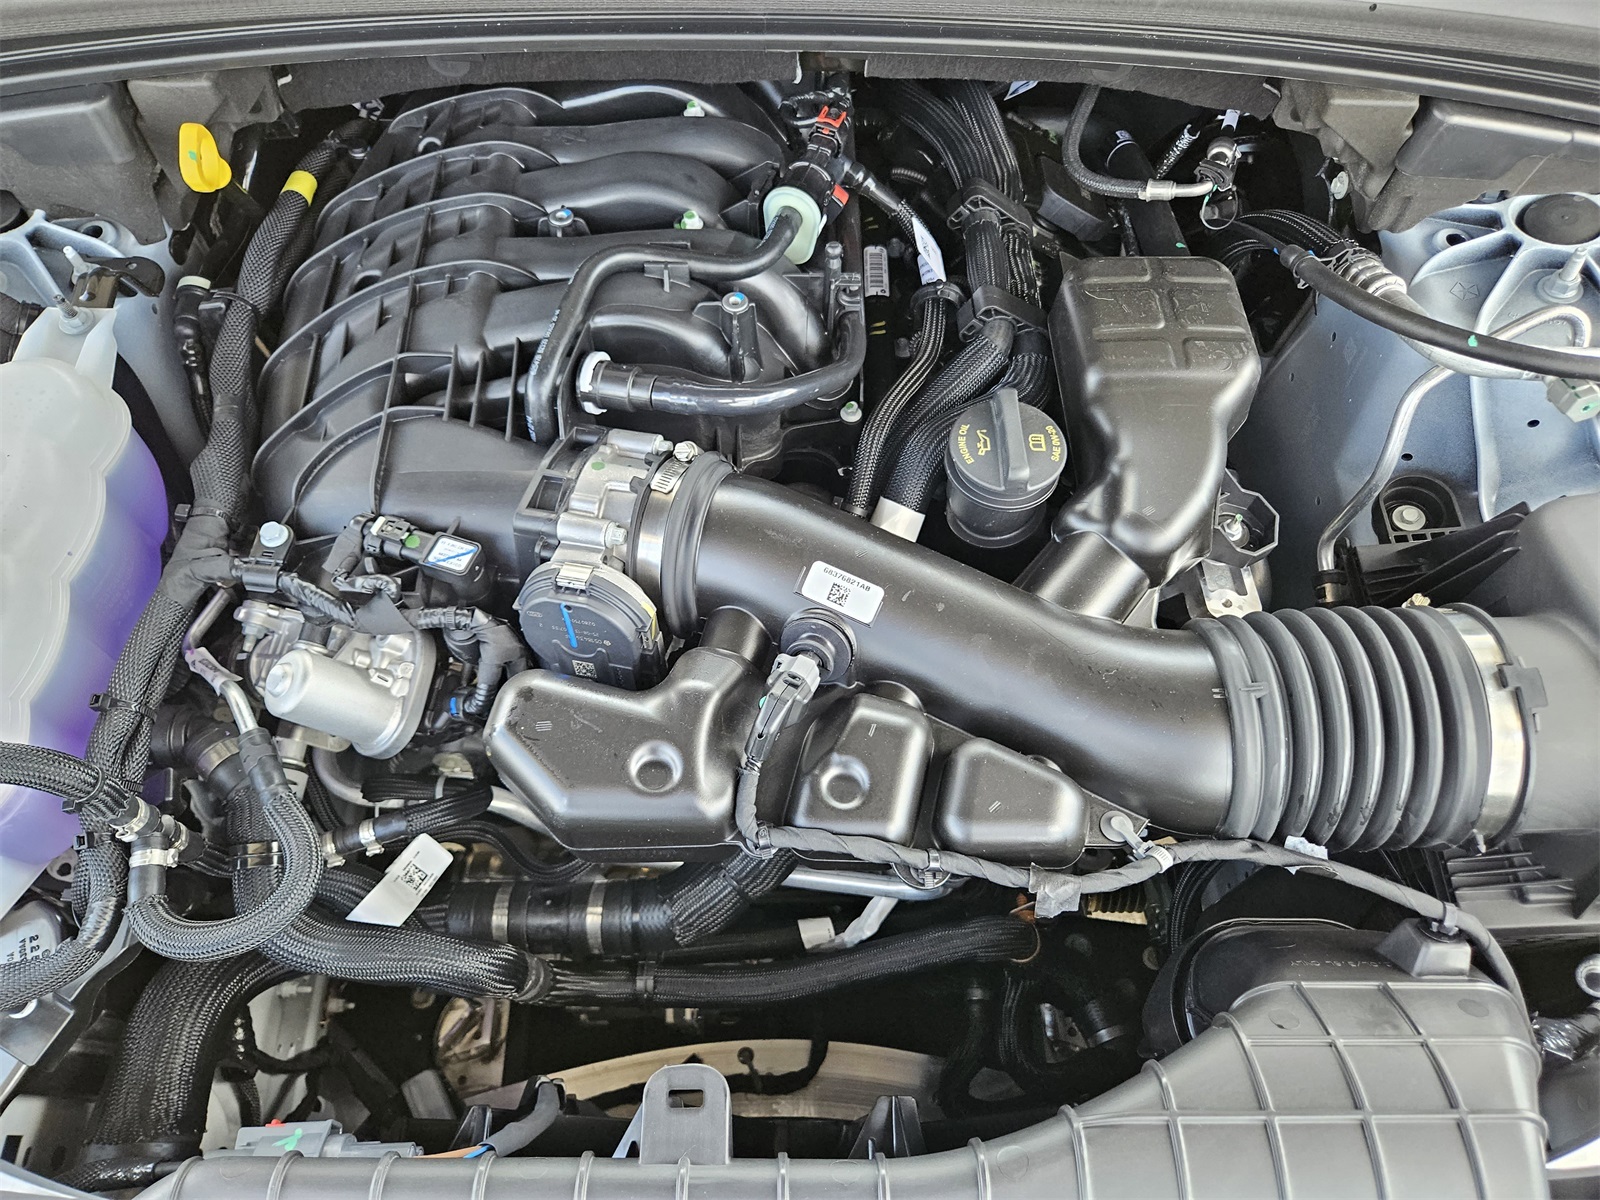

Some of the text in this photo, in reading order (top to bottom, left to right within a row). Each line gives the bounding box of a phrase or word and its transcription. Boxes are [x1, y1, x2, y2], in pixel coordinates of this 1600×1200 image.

[958, 424, 974, 464] ENGINE OIL
[1045, 425, 1060, 462] SAE 0W-20
[823, 566, 871, 592] 68376821AB
